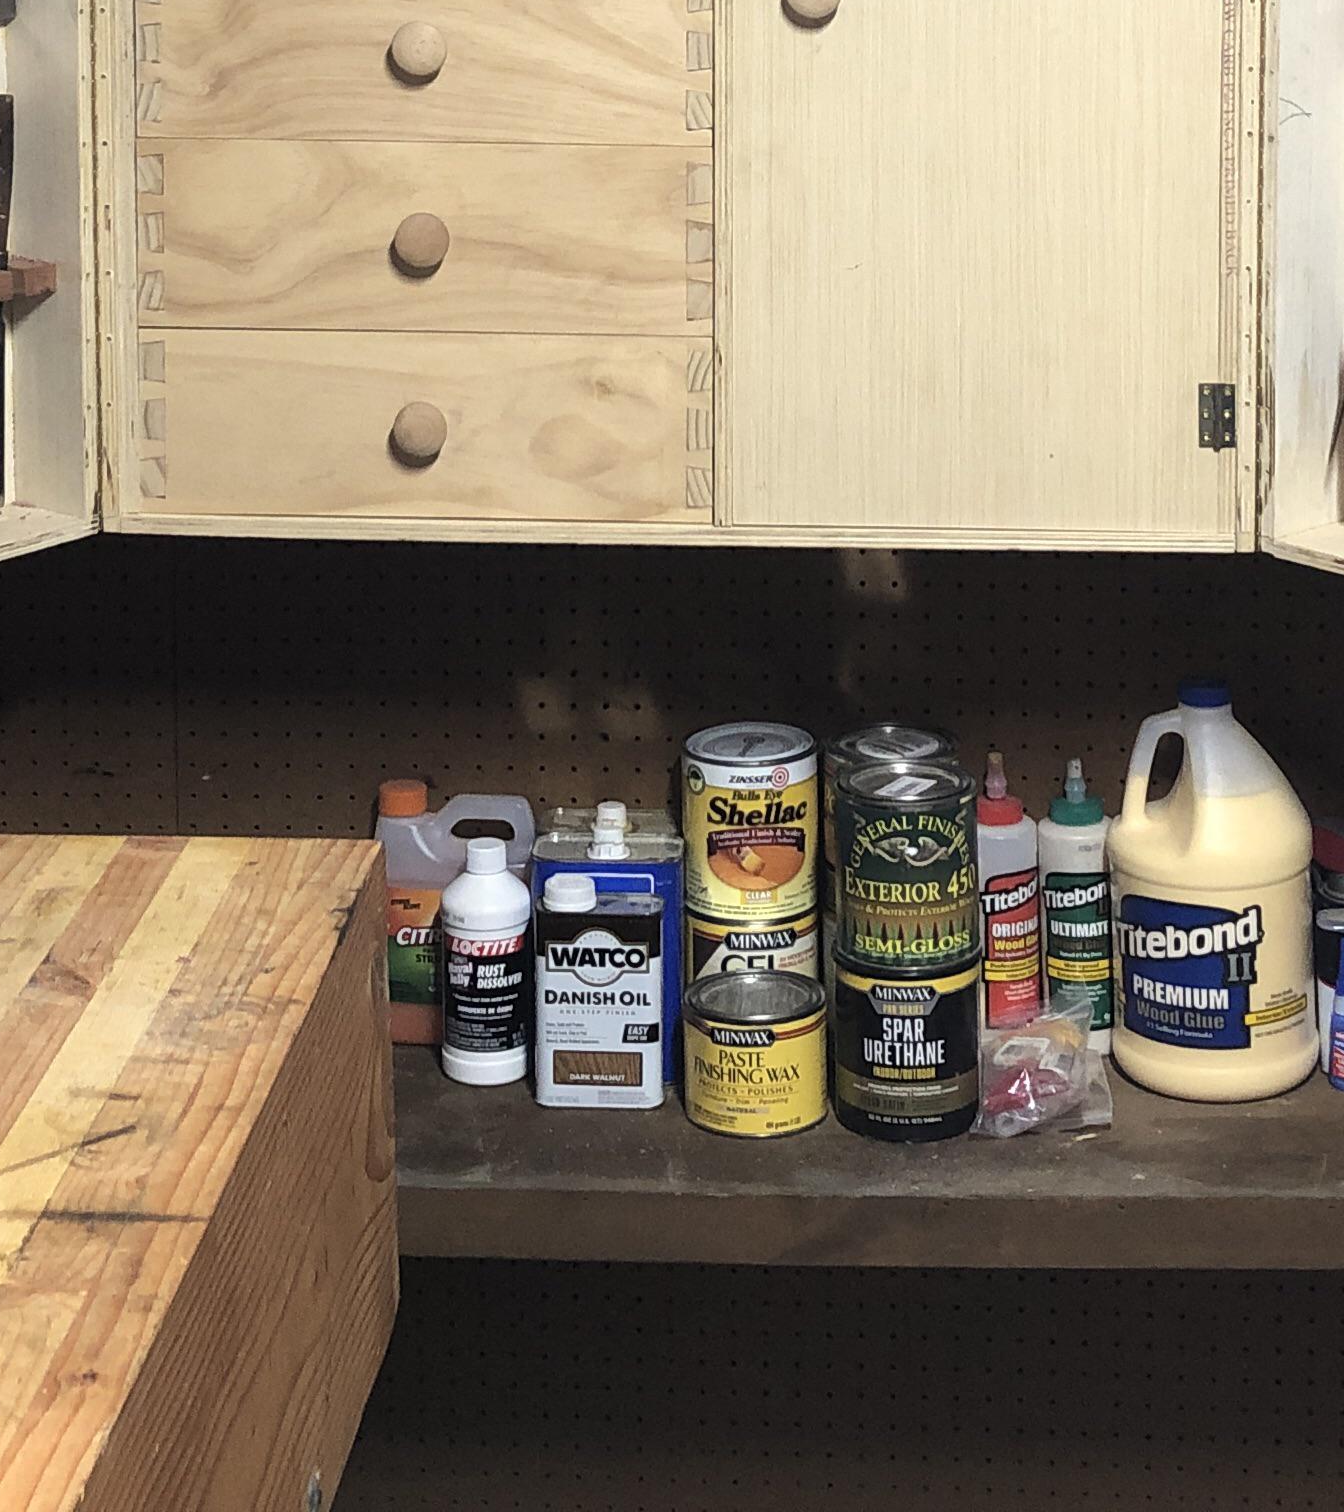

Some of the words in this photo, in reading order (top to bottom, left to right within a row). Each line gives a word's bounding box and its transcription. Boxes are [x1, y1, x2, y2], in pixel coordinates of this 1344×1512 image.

[706, 796, 808, 826] Shellac
[849, 814, 913, 868] GENERAL
[917, 814, 970, 865] FINISHES
[844, 864, 941, 904] EXTERIOR
[946, 862, 976, 900] 450
[745, 890, 772, 900] CLEAR
[730, 930, 793, 949] MINWAX
[854, 928, 970, 954] SEMI-GLOSS
[1116, 908, 1258, 959] Titebond
[451, 937, 518, 956] LOCTITE
[994, 938, 1025, 951] Wood
[550, 946, 646, 969] WATCO
[1227, 952, 1252, 982] II
[477, 963, 506, 978] RUST
[477, 972, 523, 989] DISSOLVER
[544, 989, 616, 1006] DANISH
[619, 990, 652, 1007] OIL
[876, 986, 932, 1001] MINWAX
[1132, 972, 1230, 1010] PREMIUM
[1136, 999, 1180, 1025] Wood
[1184, 1011, 1225, 1030] Glue
[627, 1025, 650, 1035] EASY
[713, 1029, 772, 1046] MINWAX
[882, 1017, 925, 1042] SPAR
[719, 1049, 766, 1068] PASTE
[863, 1037, 946, 1067] URETHANE
[569, 1073, 591, 1082] DARK
[592, 1073, 626, 1082] WALNUT
[693, 1055, 763, 1084] FINISHING
[766, 1063, 800, 1082] WAX
[747, 1085, 794, 1096] POLISHES
